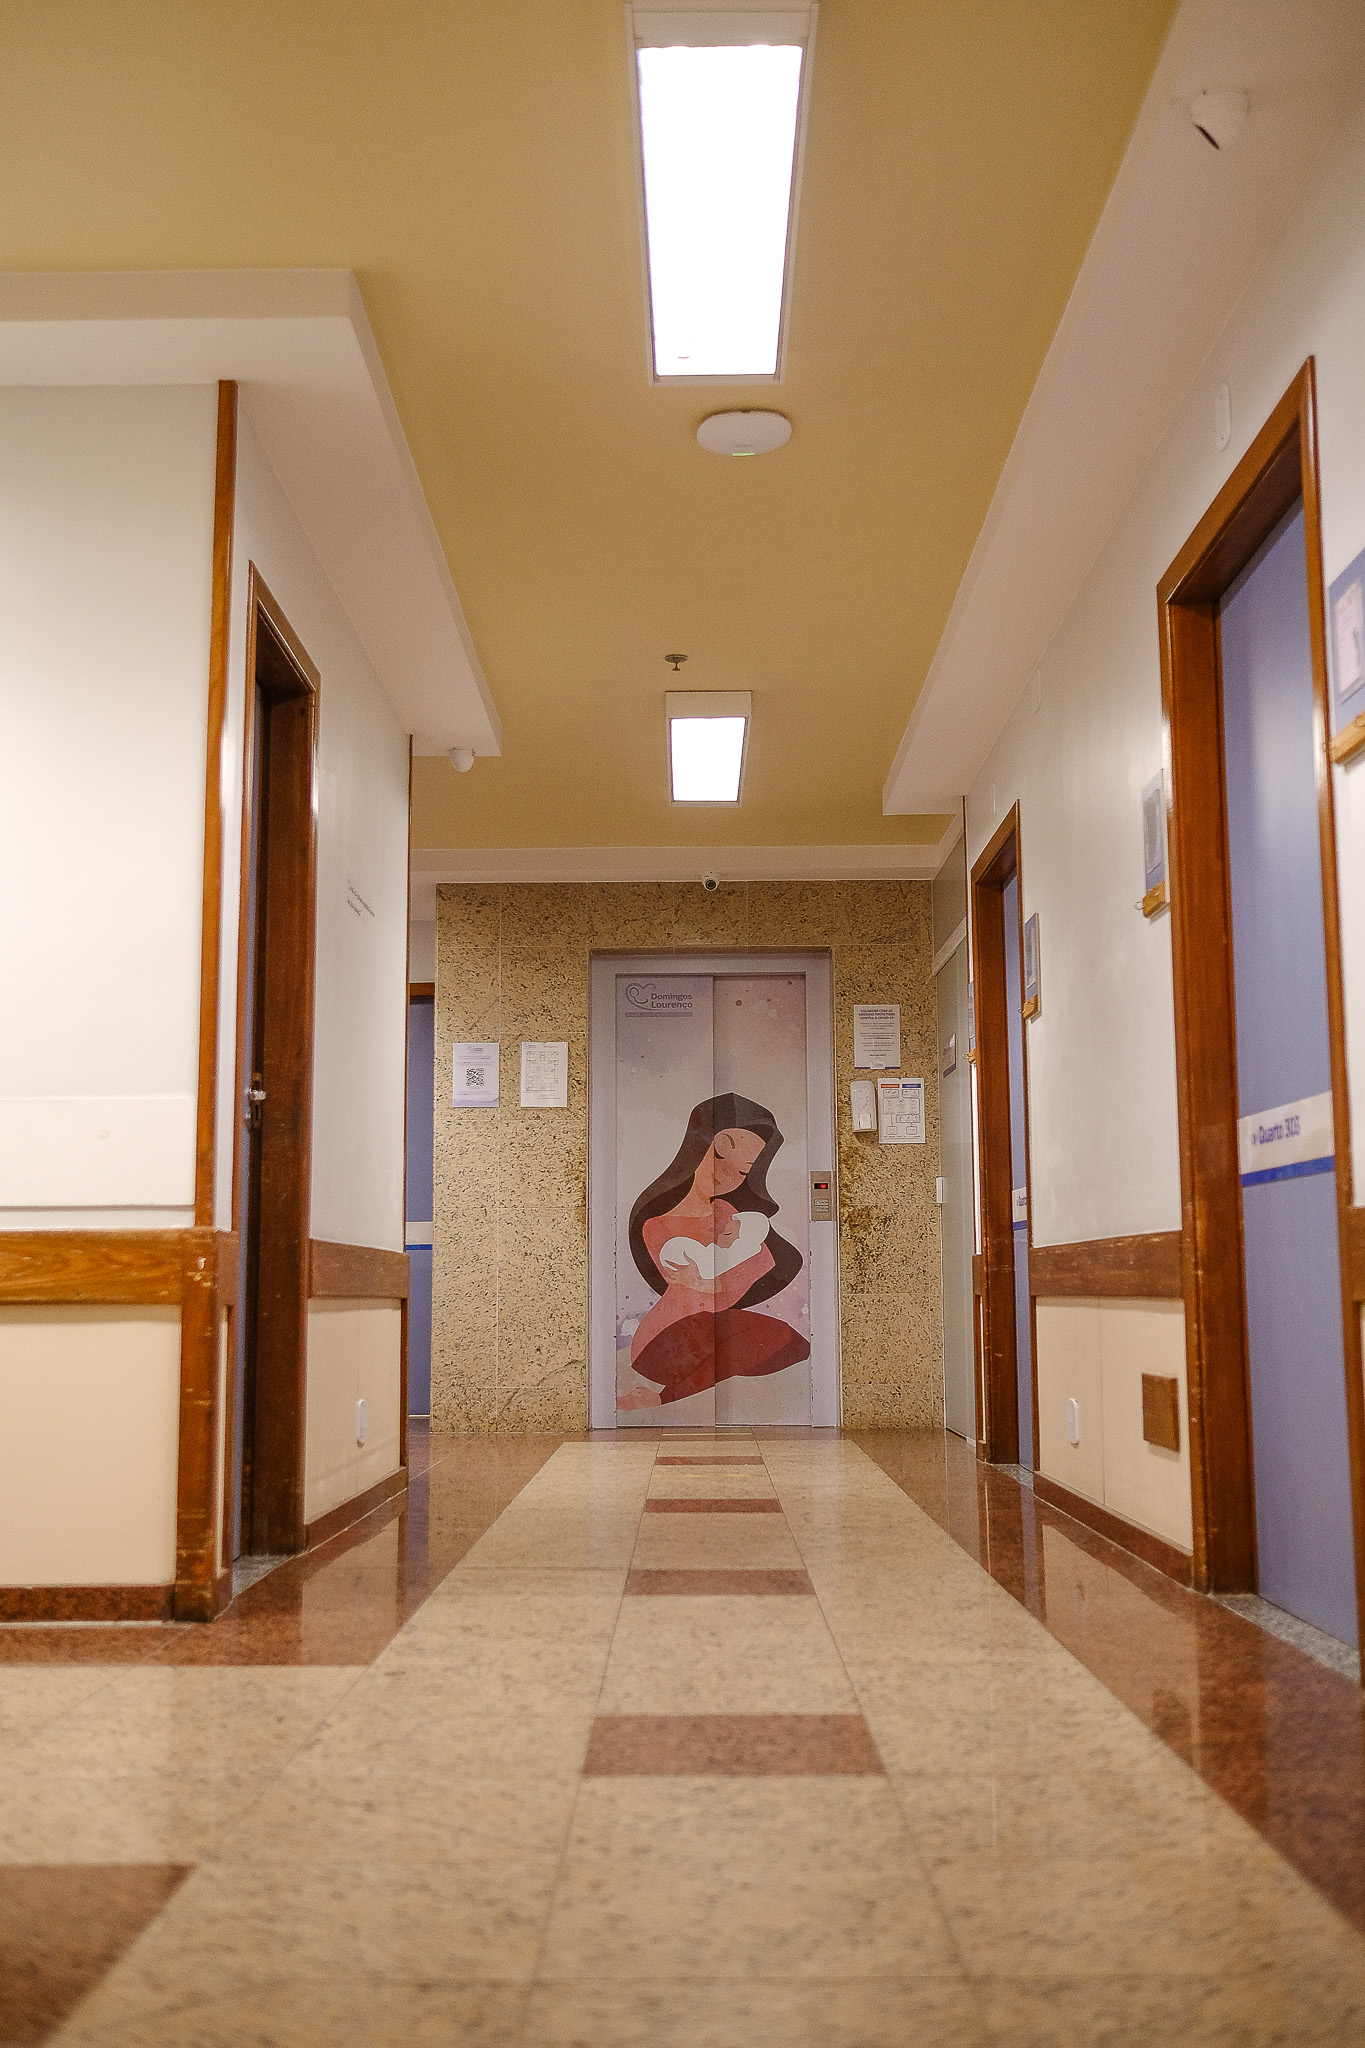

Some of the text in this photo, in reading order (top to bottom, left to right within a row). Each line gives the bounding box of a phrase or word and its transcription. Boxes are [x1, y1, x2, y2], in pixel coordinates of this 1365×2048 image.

[651, 993, 693, 1001] Domingos
[651, 1001, 693, 1010] Lourenço
[1259, 1124, 1284, 1144] Quarto
